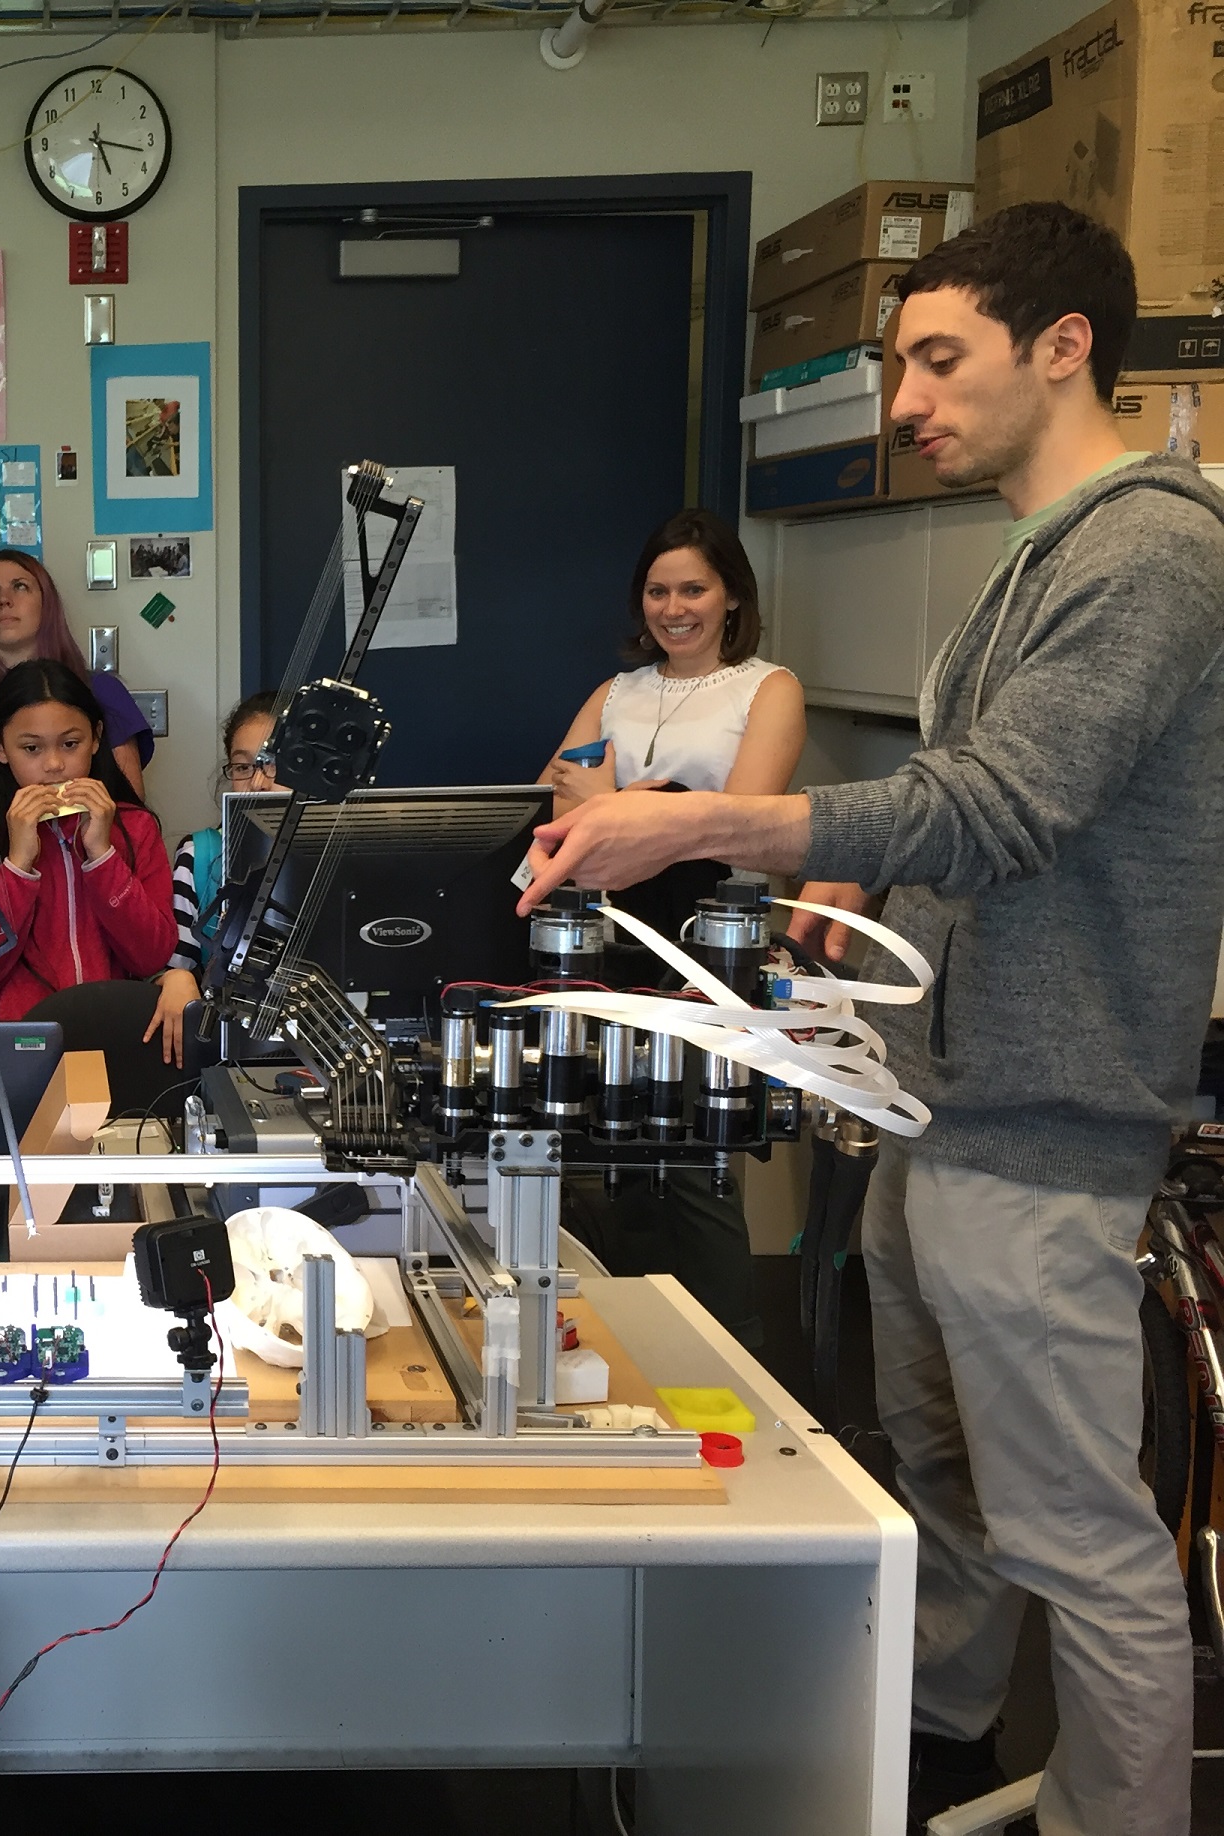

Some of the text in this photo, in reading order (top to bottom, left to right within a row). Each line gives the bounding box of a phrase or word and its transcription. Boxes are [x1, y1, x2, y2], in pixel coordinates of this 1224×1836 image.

[1063, 18, 1124, 78] fractal
[91, 80, 103, 93] 12
[120, 86, 126, 99] 1
[64, 88, 76, 102] 11
[45, 109, 58, 123] 10
[139, 105, 147, 119] 2
[41, 138, 49, 152] 9
[147, 133, 154, 147] 3
[49, 166, 56, 179] 8
[141, 161, 148, 175] 4
[70, 186, 76, 198] 7
[122, 183, 129, 196] 5
[96, 191, 103, 205] 6
[883, 192, 948, 209] ASUS
[372, 925, 420, 937] ViewSonic
